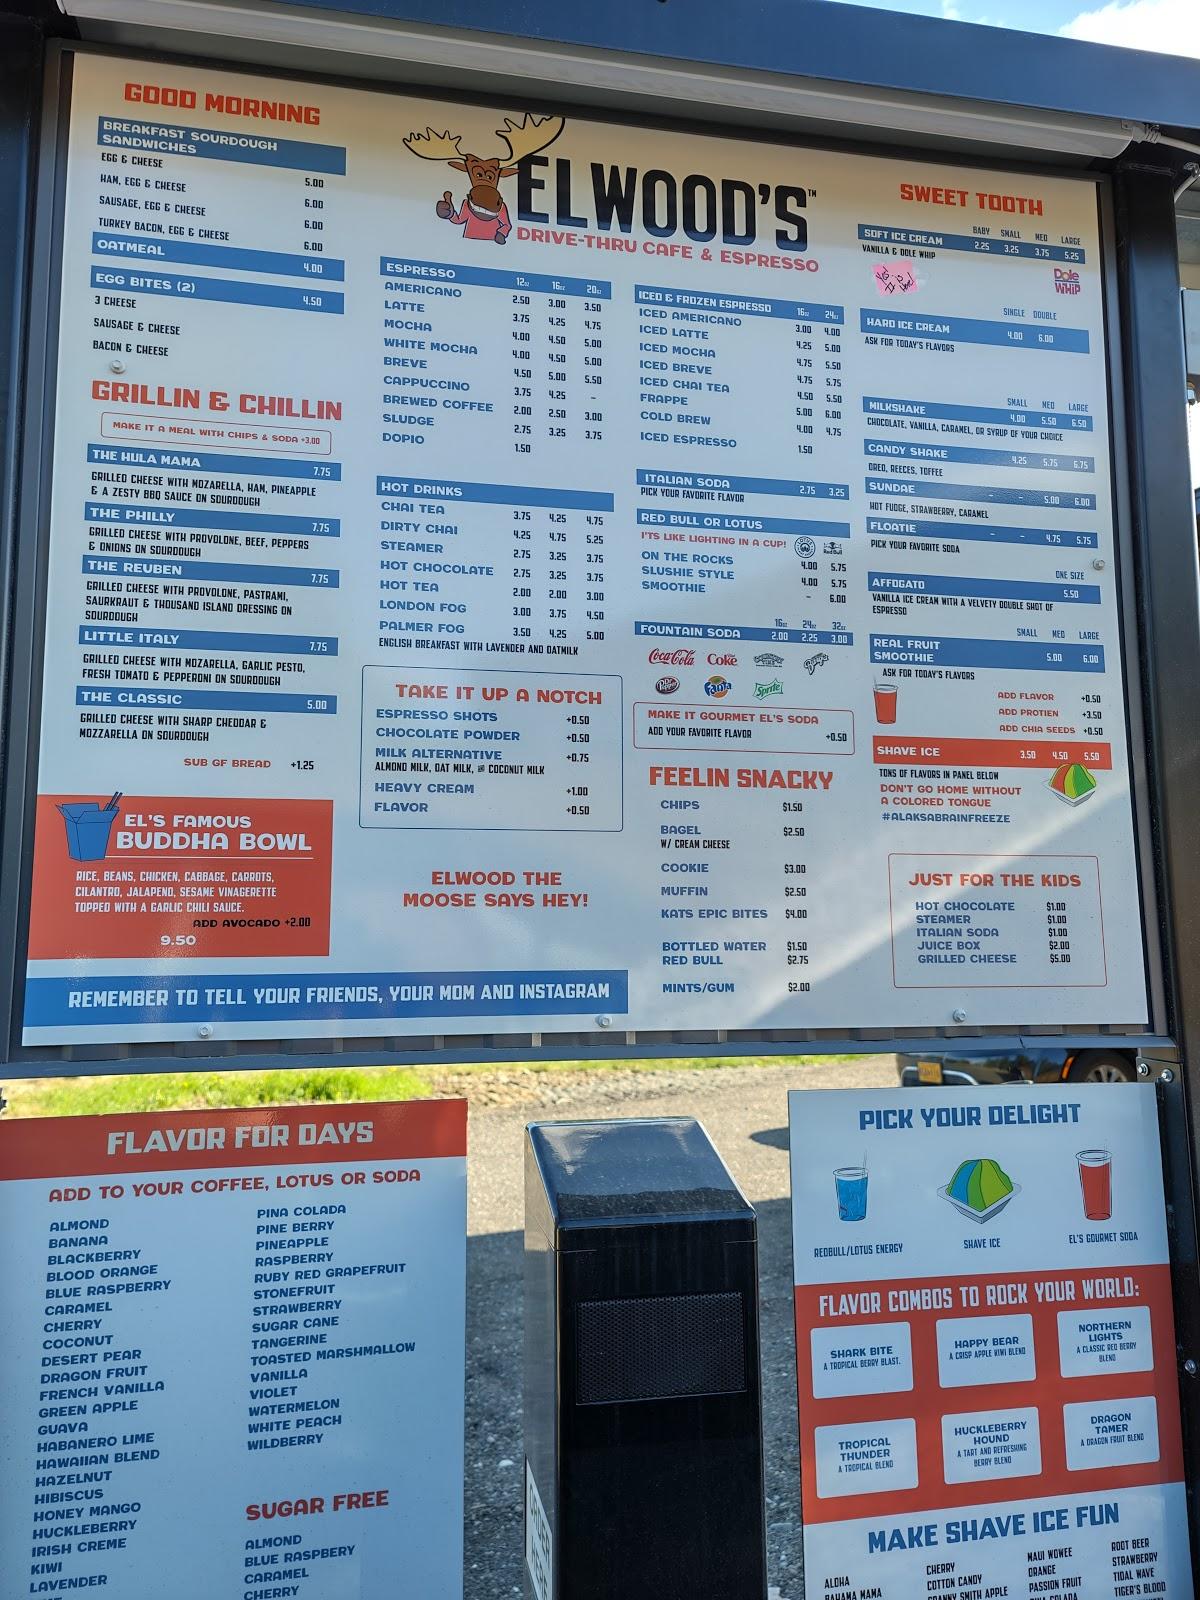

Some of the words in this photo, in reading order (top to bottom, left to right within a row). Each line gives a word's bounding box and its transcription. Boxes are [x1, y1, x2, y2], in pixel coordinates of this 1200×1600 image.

[125, 83, 196, 109] GOOD
[205, 93, 320, 125] MORNING
[103, 132, 199, 153] SANDWICHES
[104, 121, 185, 139] BREAKFAST
[191, 132, 277, 151] SOURDOUGH
[101, 174, 121, 185] HAM,
[125, 177, 140, 187] EGG
[145, 179, 151, 189] &
[155, 181, 186, 192] CHEESE
[305, 199, 324, 210] 6.00
[901, 184, 968, 207] SWEET
[976, 193, 1043, 216] TOOTH
[97, 240, 165, 255] OATMEAL
[304, 263, 323, 274] 4.00
[517, 227, 637, 253] DRIVE-THRU
[643, 242, 692, 259] CAFE
[701, 248, 713, 262] &
[721, 250, 819, 272] ESPRESSO
[862, 244, 889, 254] VANILLA
[892, 248, 898, 256] &
[900, 249, 916, 257] DOLE
[919, 251, 935, 259] WHIP
[385, 282, 462, 297] AMERICANO
[513, 295, 531, 305] 2.50
[549, 299, 566, 309] 3.00
[585, 303, 602, 313] 3.50
[639, 291, 662, 301] ICED
[665, 294, 674, 303] &
[677, 295, 716, 307] FROZEN
[719, 300, 771, 312] ESPRESSO
[92, 380, 200, 409] GRILLIN
[209, 392, 231, 412] &
[240, 394, 342, 420] CHILLIN
[640, 377, 668, 387] ICED
[673, 380, 702, 390] CHAI
[706, 383, 729, 393] TEA
[797, 392, 814, 401] 4.50
[826, 394, 843, 404] 5.50
[870, 402, 926, 414] MILKSHAKE
[1010, 414, 1026, 424] 4.00
[1041, 417, 1057, 426] 5.50
[1072, 419, 1087, 429] 6.50
[113, 422, 141, 430] MAKE
[169, 427, 195, 435] MEAL
[200, 429, 224, 437] WITH
[272, 435, 298, 443] SODA
[867, 417, 907, 429] CHOCOLATE,
[910, 421, 938, 432] VANILLA,
[941, 424, 973, 435] CARAMEL,
[976, 427, 985, 436] OR
[987, 428, 1008, 436] SYRUP
[1011, 430, 1019, 438] OF
[1021, 431, 1037, 439] YOUR
[1040, 432, 1063, 441] CHOICE
[93, 449, 117, 460] THE
[121, 452, 157, 464] HULA
[161, 455, 201, 467] MAMA
[314, 467, 331, 477] 7.75
[642, 532, 660, 540] I'TS
[664, 533, 685, 541] LIKE
[689, 535, 735, 544] LIGHTING
[739, 538, 749, 546] IN
[753, 539, 760, 547] A
[763, 540, 786, 548] CUP!
[381, 560, 408, 570] HOT
[413, 563, 493, 575] CHOCOLATE
[514, 569, 531, 579] 2.75
[550, 571, 567, 581] 3.25
[587, 573, 604, 583] 3.75
[396, 684, 448, 699] TAKE
[457, 687, 475, 701] IT
[482, 688, 509, 702] UP
[517, 689, 530, 703] A
[537, 690, 601, 704] NOTCH
[704, 678, 732, 695] Fanta
[756, 683, 781, 697] Sprite
[1021, 709, 1058, 717] PROTIEN
[1082, 711, 1102, 719] +3.50
[650, 767, 729, 787] FEELIN
[737, 769, 833, 789] SNACKY
[882, 813, 1010, 823] #ALAKSABRAINFREEZE
[117, 832, 228, 849] BUDDHA
[240, 833, 312, 850] BOWL
[404, 893, 476, 907] MOOSE
[484, 893, 534, 907] SAYS
[543, 894, 588, 907] HEY!
[917, 941, 952, 950] JUICE
[957, 941, 980, 950] BOX
[1049, 941, 1069, 950] $2.00
[69, 990, 168, 1008] REMEMBER
[176, 990, 199, 1006] TO
[205, 989, 246, 1005] TELL
[254, 988, 300, 1004] YOUR
[307, 987, 383, 1003] FRIENDS,
[389, 986, 433, 1001] YOUR
[440, 985, 474, 1000] MOM
[481, 985, 513, 999] AND
[520, 983, 609, 999] INSTAGRAM
[860, 1109, 913, 1130] PICK
[920, 1107, 981, 1127] YOUR
[988, 1104, 1081, 1125] DELIGHT
[107, 1128, 225, 1155] FLAVOR
[235, 1125, 289, 1148] FOR
[299, 1122, 373, 1145] DAYS
[49, 1188, 91, 1202] ADD
[99, 1185, 125, 1200] TO
[132, 1182, 183, 1197] YOUR
[191, 1177, 269, 1193] COFFEE,
[277, 1174, 334, 1188] LOTUS
[341, 1172, 366, 1186] OR
[373, 1169, 420, 1183] SODA
[48, 1249, 141, 1265] BLACKBERRY
[814, 1245, 873, 1257] REDBULL/LOTUS
[876, 1243, 903, 1254] ENERGY
[254, 1272, 289, 1283] RUBY
[295, 1270, 321, 1280] RED
[326, 1263, 406, 1277] GRAPEFRUIT
[820, 1292, 881, 1316] FLAVOR
[888, 1288, 952, 1312] COMBOS
[959, 1286, 980, 1308] TO
[986, 1283, 1028, 1305] ROCK
[1034, 1281, 1075, 1302] YOUR
[1082, 1277, 1139, 1299] WORLD:
[831, 1348, 866, 1358] SHARK
[870, 1346, 893, 1355] BITE
[824, 1363, 829, 1371] A
[830, 1360, 858, 1370] TROPICAL
[860, 1358, 878, 1367] BERRY
[881, 1357, 901, 1366] BLAST.
[36, 1454, 108, 1470] HAWAIIAN
[114, 1450, 160, 1463] BLEND
[246, 1498, 324, 1520] SUGAR
[333, 1490, 389, 1511] FREE
[868, 1524, 938, 1553] MAKE
[946, 1514, 1026, 1543] SHAVE
[1033, 1509, 1069, 1533] ICE
[1076, 1503, 1119, 1527] FUN
